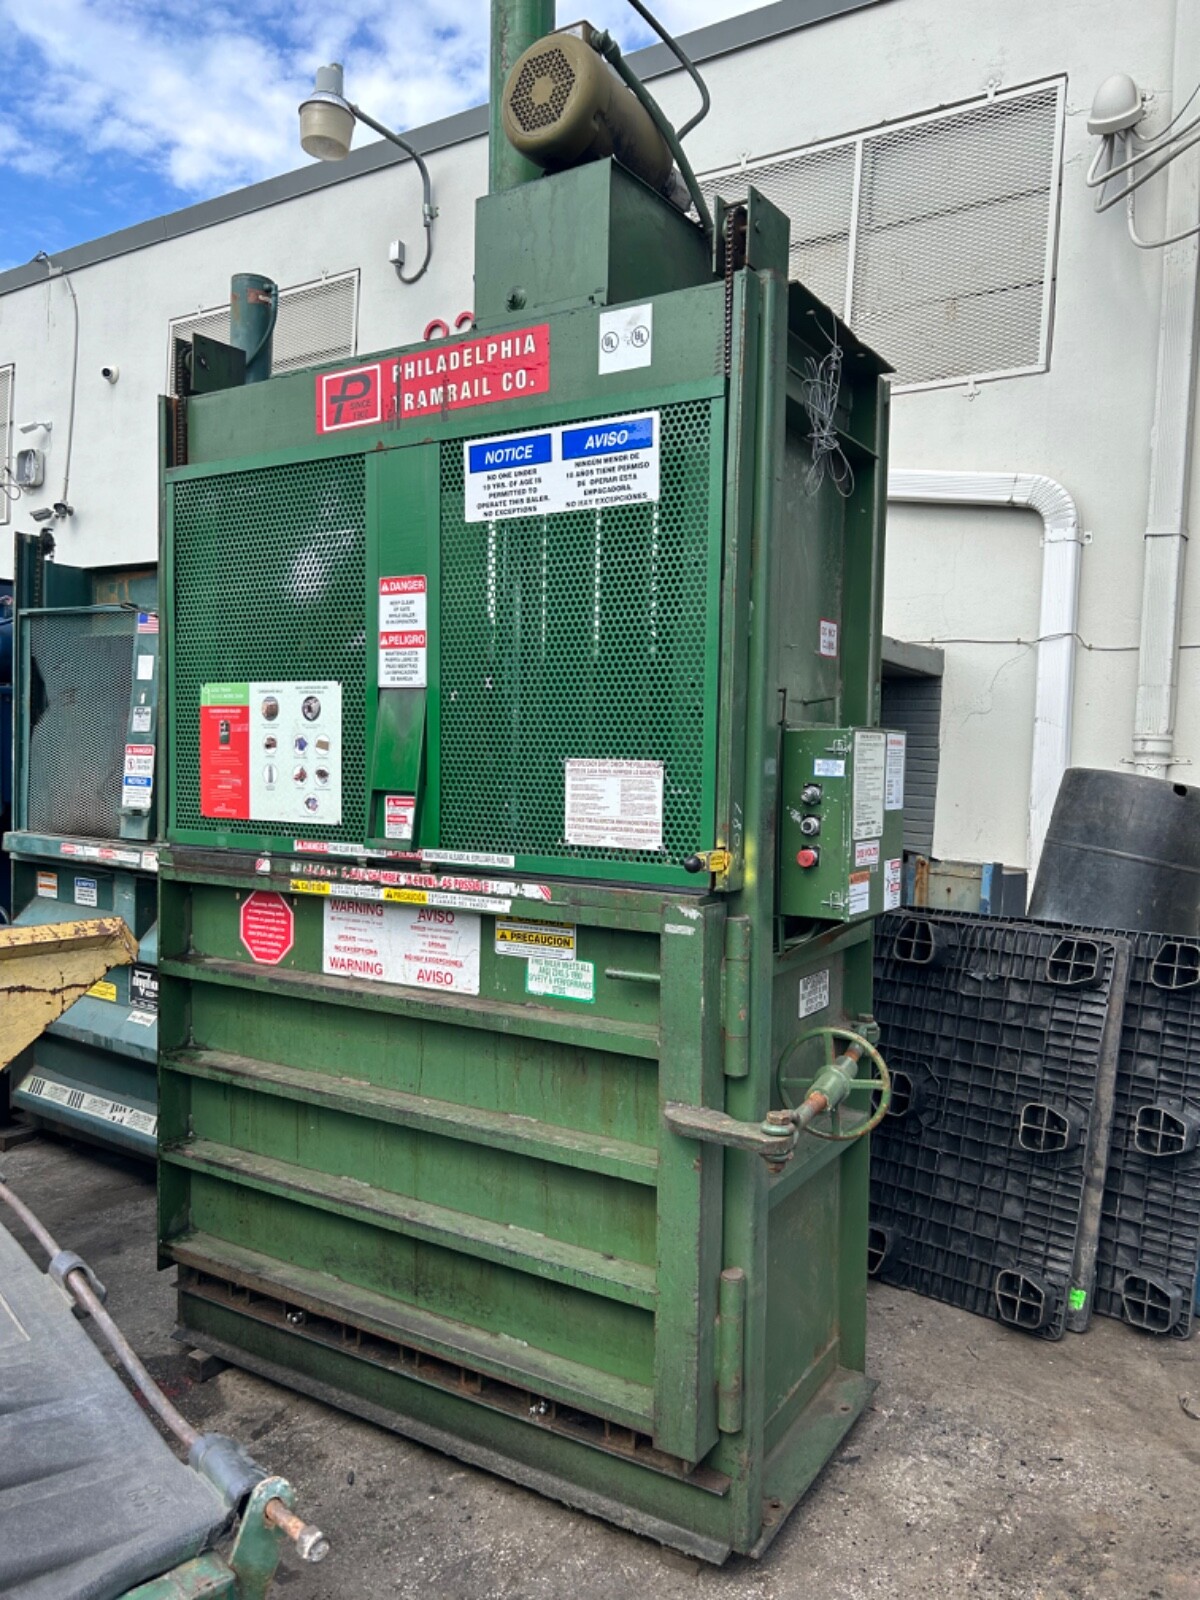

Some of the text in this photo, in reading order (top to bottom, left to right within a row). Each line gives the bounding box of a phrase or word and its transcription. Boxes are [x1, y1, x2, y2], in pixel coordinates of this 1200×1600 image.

[392, 334, 536, 383] PHILADELPHIA
[502, 369, 535, 392] CO.
[584, 429, 629, 450] AVISO
[485, 445, 534, 465] NOTICE
[603, 453, 628, 464] MENOR
[630, 452, 640, 460] DE
[596, 466, 616, 475] TIENE
[617, 461, 650, 472] PERMISO
[519, 477, 533, 486] AGE
[589, 476, 618, 486] OPERAR
[488, 488, 527, 499] PERMITTED
[476, 499, 507, 510] OPERATE
[509, 498, 525, 506] THIS
[495, 505, 537, 516] EXCEPTIONS
[390, 580, 425, 592] DANGER
[389, 634, 425, 646] PELIGRO
[330, 898, 384, 917] WARNING
[417, 908, 455, 925] AVISO
[510, 932, 571, 947] PRECAUCION
[329, 956, 383, 976] WARNING
[417, 968, 454, 985] AVISO
